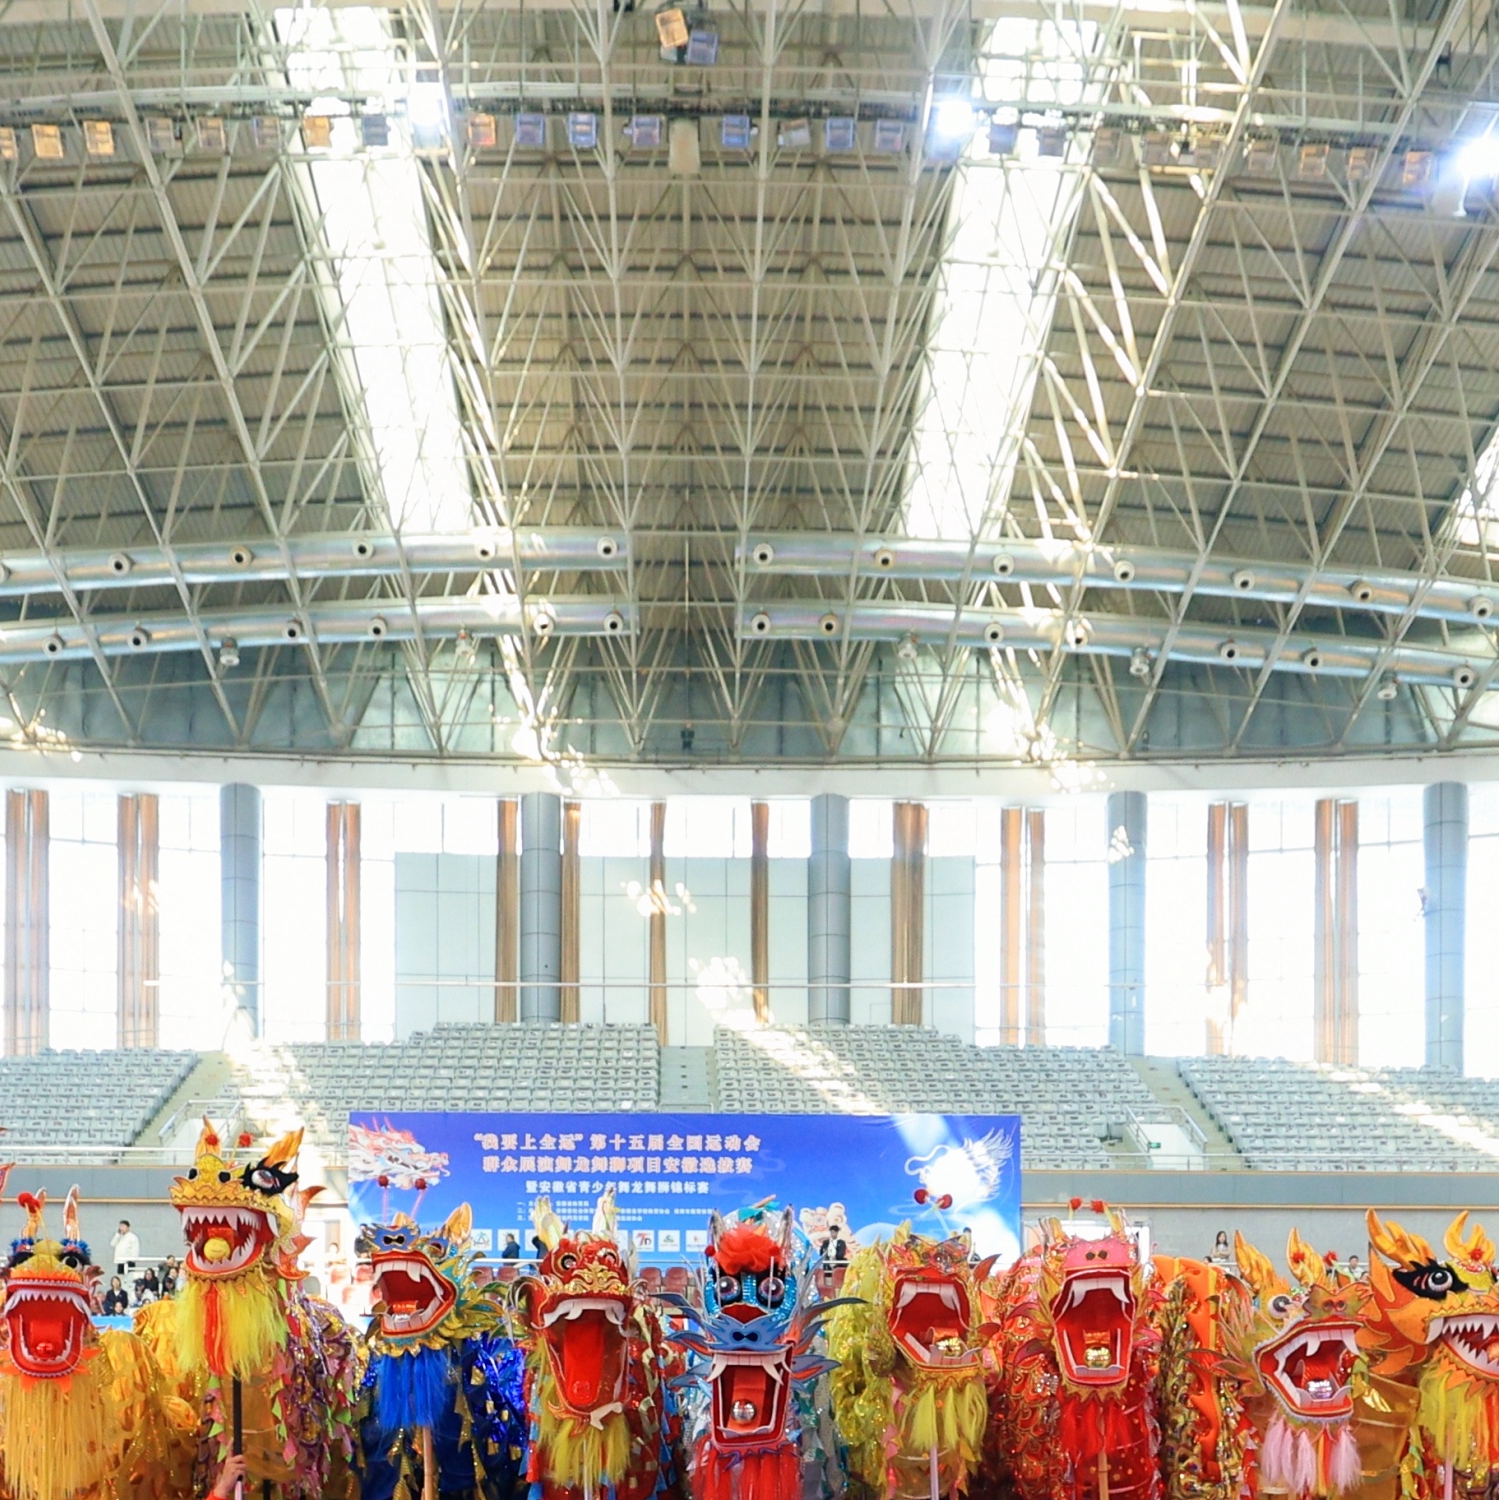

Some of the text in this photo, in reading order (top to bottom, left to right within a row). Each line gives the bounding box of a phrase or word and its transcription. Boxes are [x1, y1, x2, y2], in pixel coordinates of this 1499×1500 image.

[474, 1133, 761, 1151] “我要上全运” 第十五届全国运动会
[482, 1156, 753, 1174] 群众展演舞龙舞狮项目安徽选拔赛
